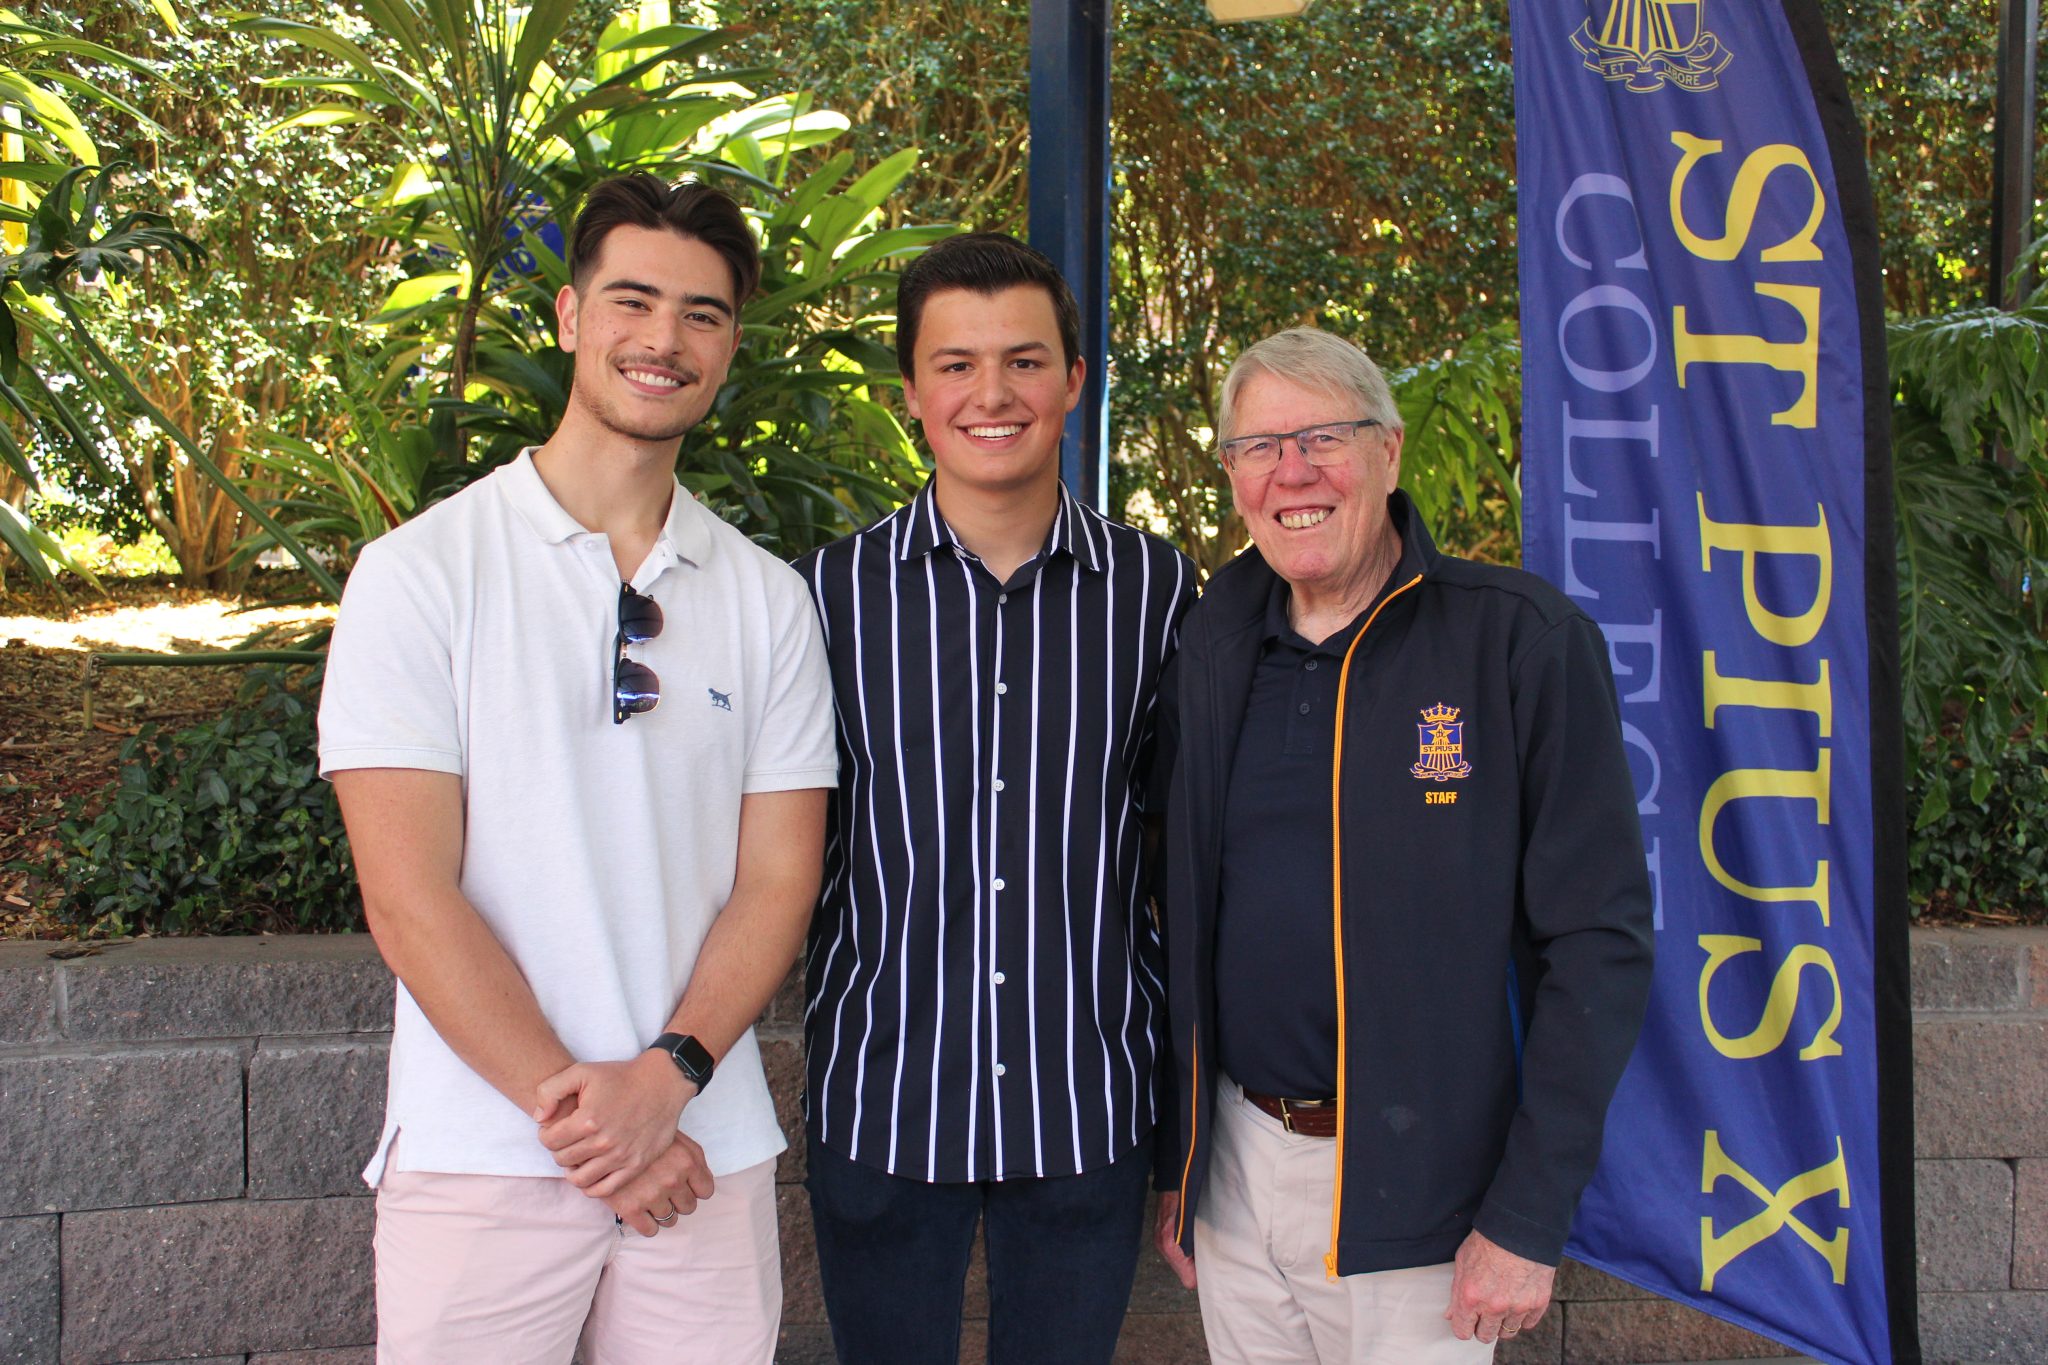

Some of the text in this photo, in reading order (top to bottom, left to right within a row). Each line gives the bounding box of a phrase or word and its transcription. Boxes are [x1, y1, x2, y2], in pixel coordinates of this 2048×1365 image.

[1610, 62, 1625, 75] ET
[1555, 172, 1664, 931] COLLE
[1669, 131, 1851, 1292] ST PIUS X
[1425, 791, 1457, 804] STAFF
